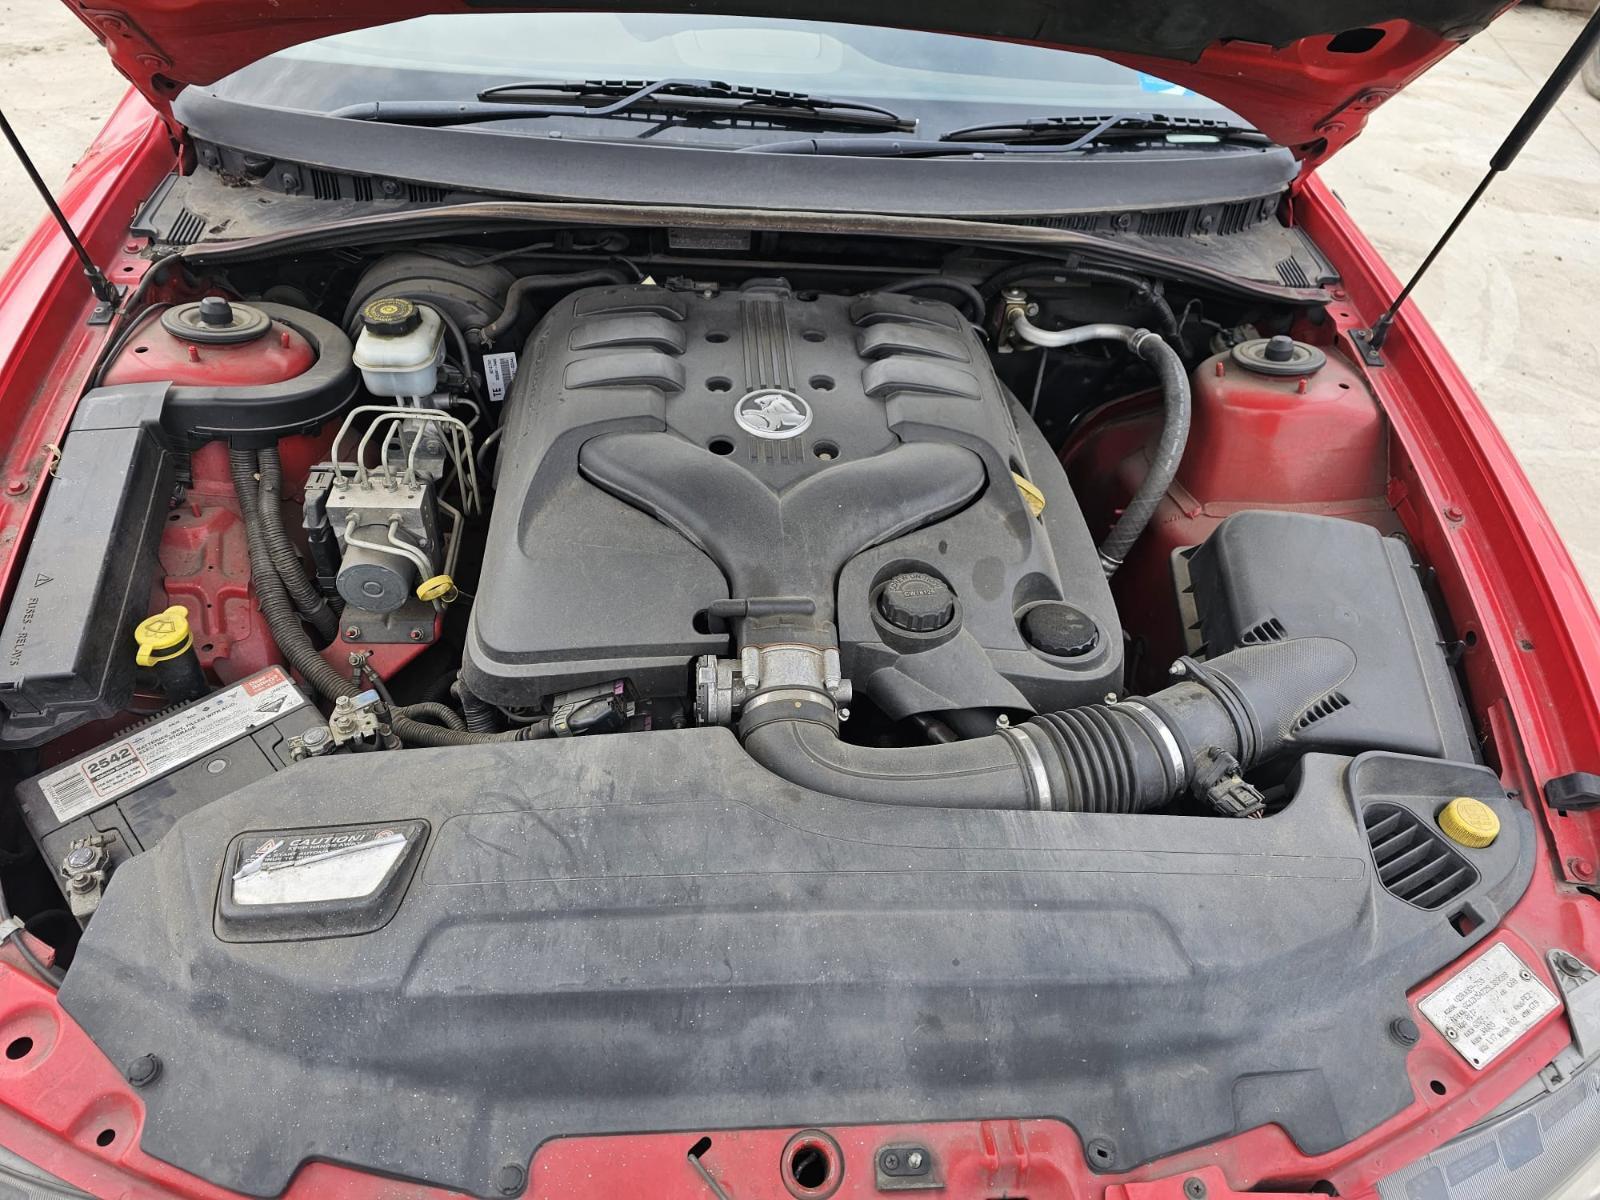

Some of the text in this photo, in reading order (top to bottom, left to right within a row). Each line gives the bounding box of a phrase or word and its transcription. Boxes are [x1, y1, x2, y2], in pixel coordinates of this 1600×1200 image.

[23, 597, 39, 624] FUSES
[9, 632, 28, 666] RELAYS
[168, 725, 196, 740] STORAGE
[87, 748, 131, 774] 2542
[289, 834, 365, 847] CAUTION!
